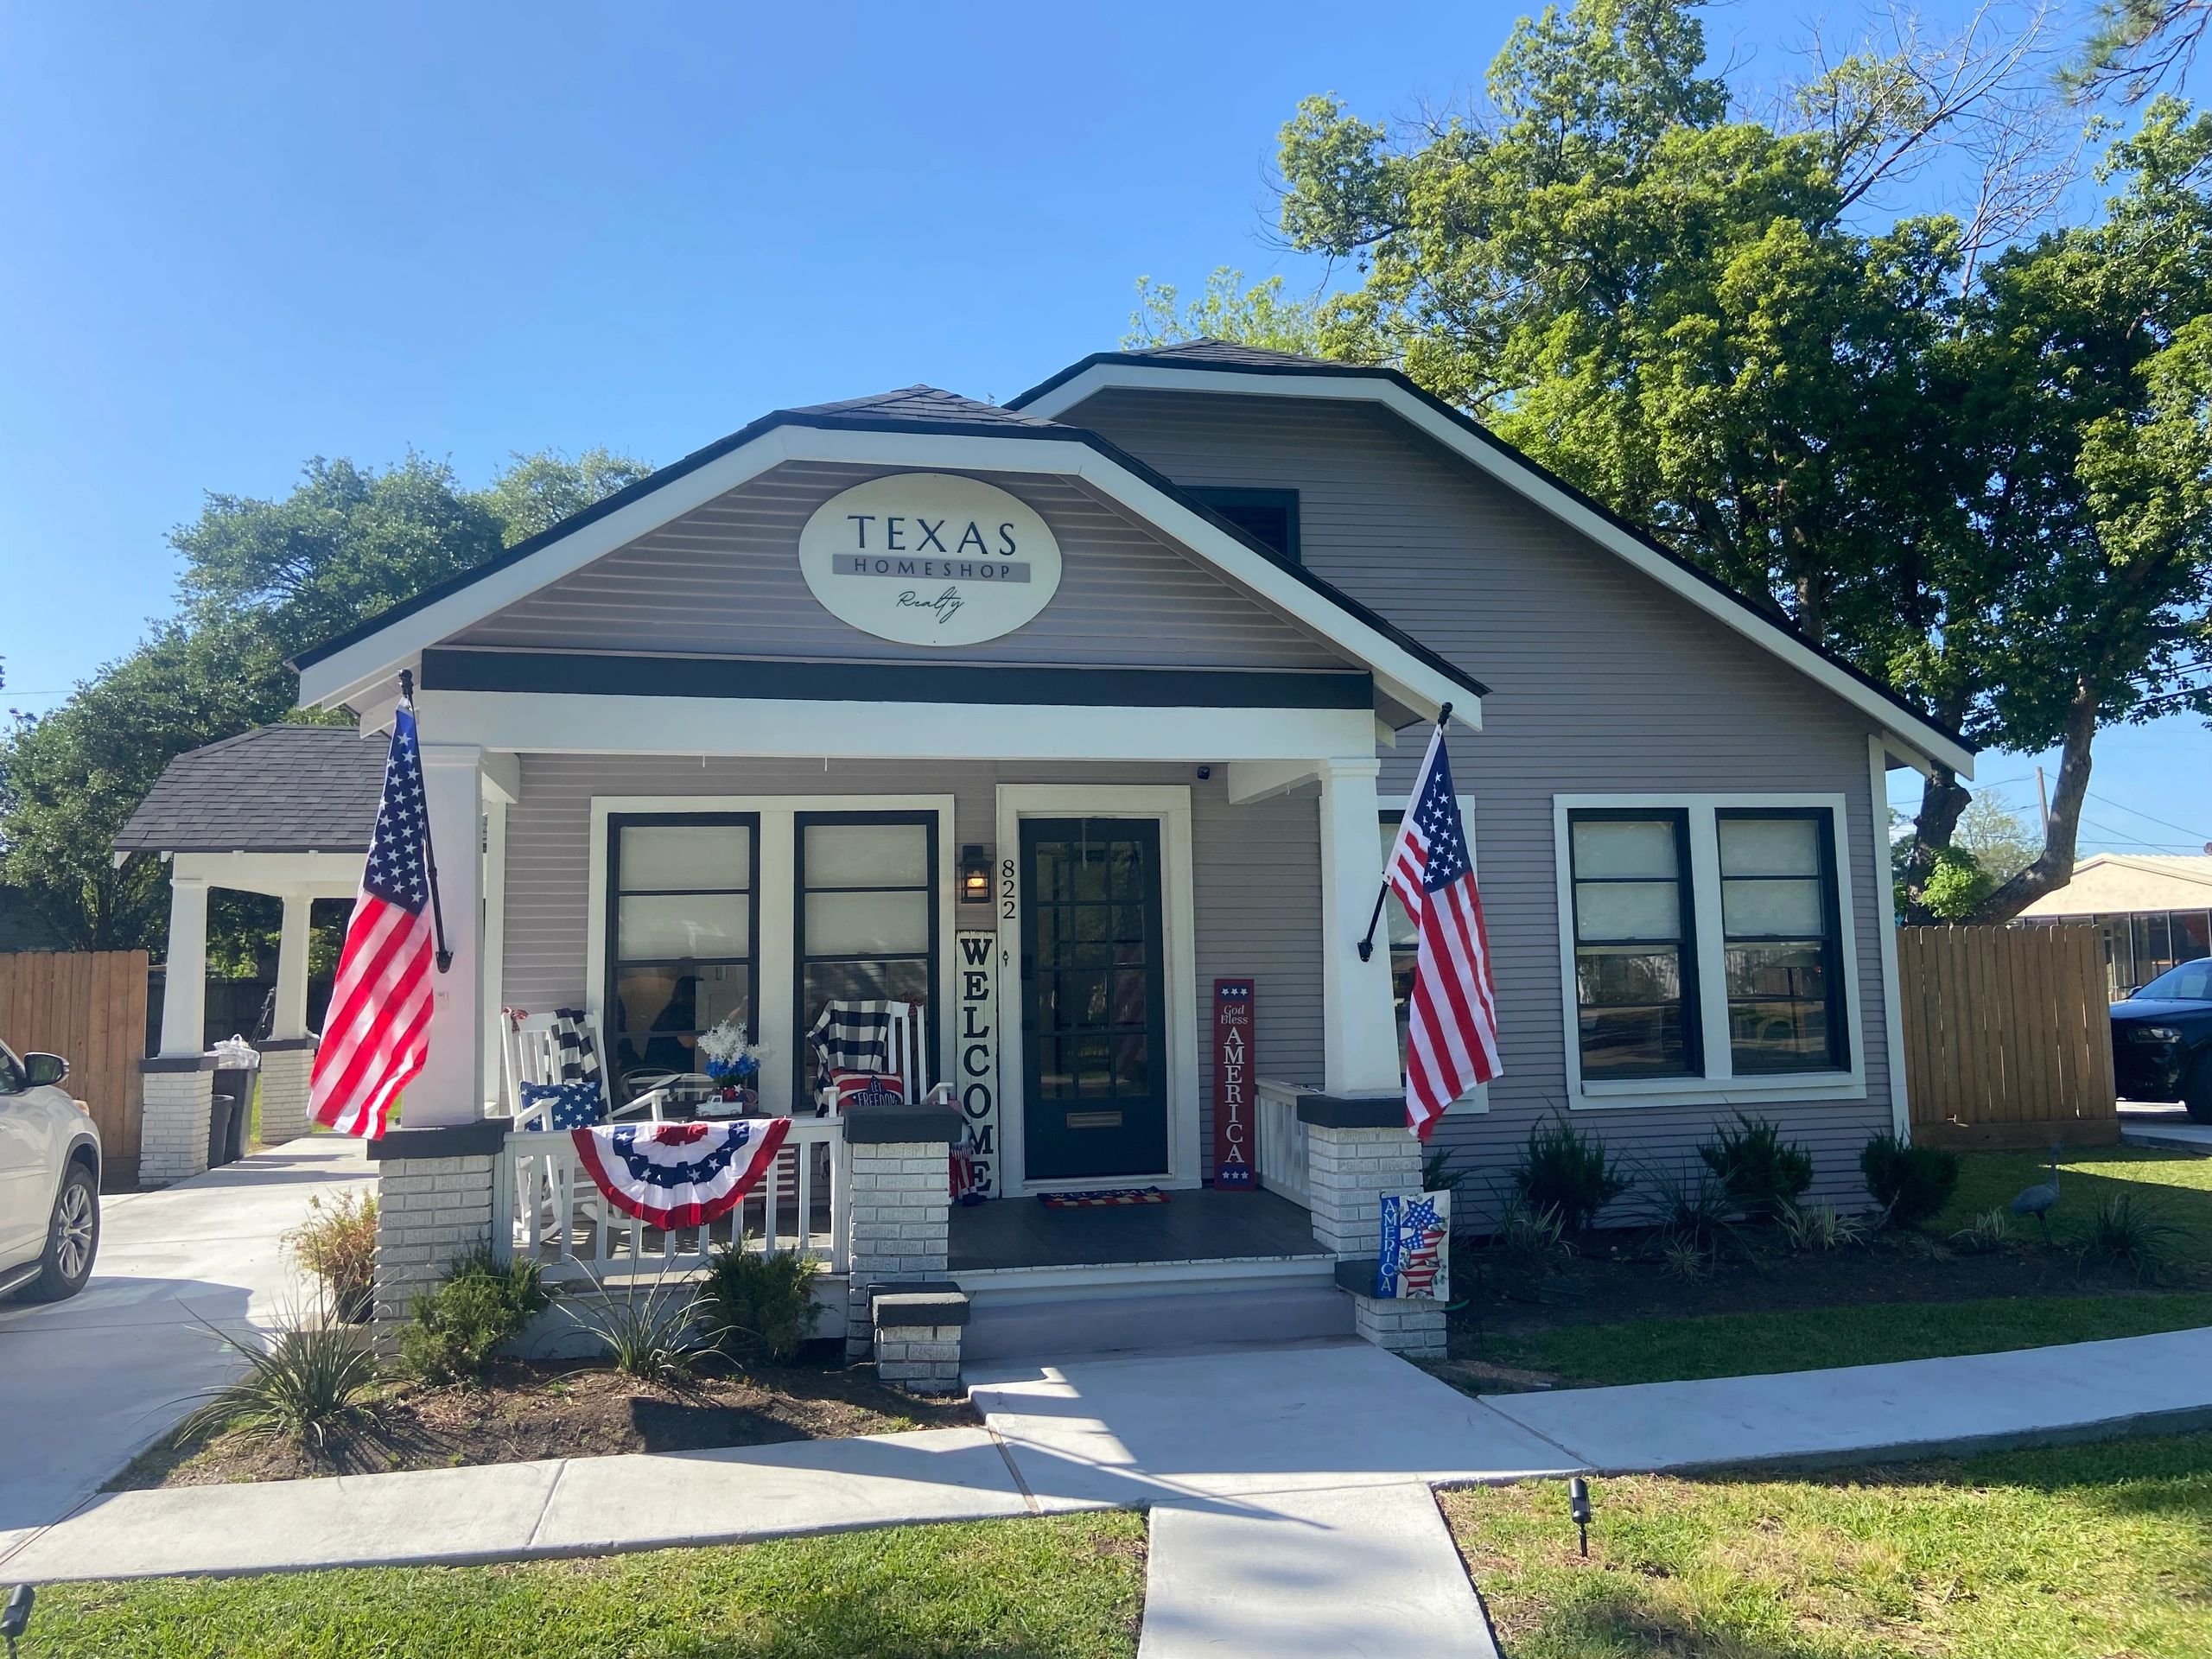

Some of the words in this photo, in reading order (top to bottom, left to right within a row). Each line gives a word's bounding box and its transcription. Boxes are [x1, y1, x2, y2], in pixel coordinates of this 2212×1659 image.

[847, 514, 1016, 556] TEXAS
[854, 557, 1010, 579] HOMESHOP
[895, 586, 965, 624] Realty
[1001, 859, 1016, 919] 822
[1220, 1014, 1249, 1026] Bless
[1224, 1004, 1245, 1015] God
[959, 938, 995, 1192] WELCOME
[871, 1080, 882, 1093] LET
[1223, 1026, 1246, 1164] AMERICA
[1380, 1198, 1398, 1293] AMERICA
